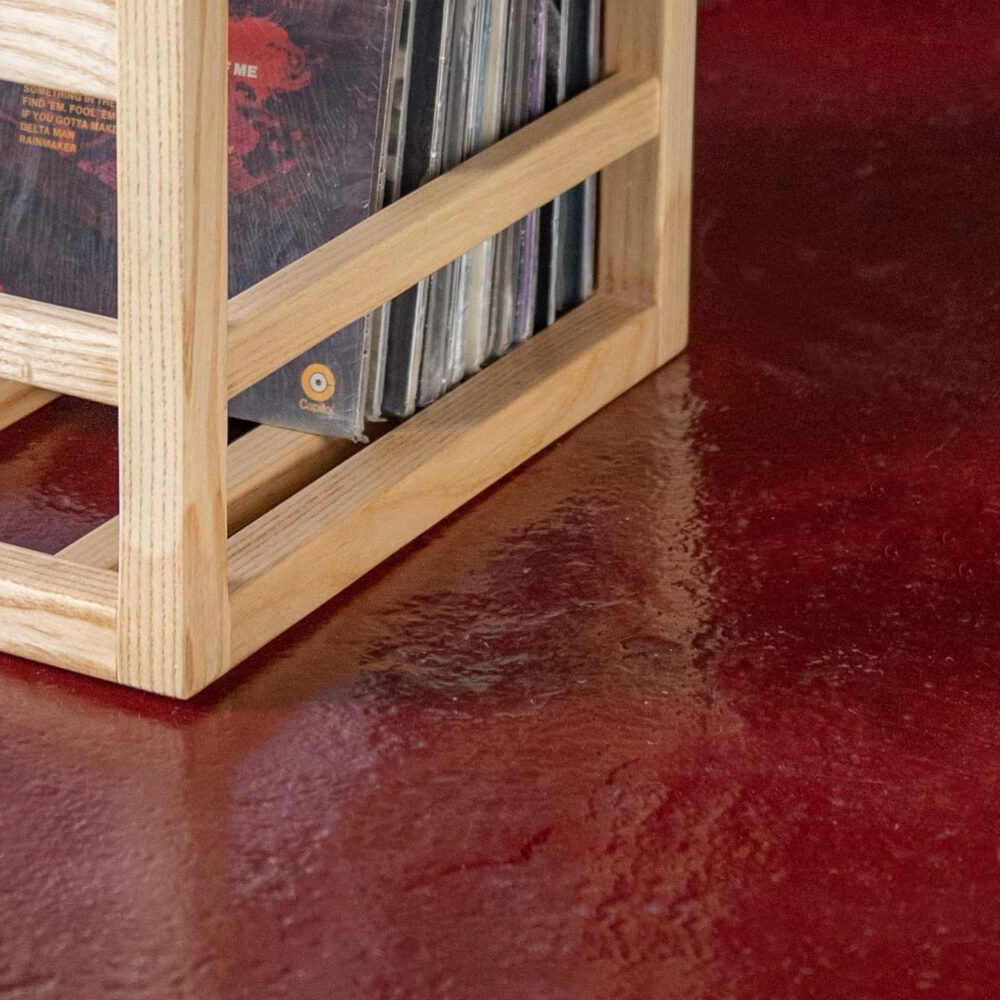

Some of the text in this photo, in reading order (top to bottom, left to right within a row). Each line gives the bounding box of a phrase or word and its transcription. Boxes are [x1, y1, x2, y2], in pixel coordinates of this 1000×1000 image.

[233, 64, 258, 79] ME
[22, 96, 46, 108] FIND
[69, 104, 96, 117] FOOL
[21, 109, 30, 118] IF
[33, 111, 53, 122] YOU
[55, 116, 89, 129] GOTTA
[20, 122, 76, 140] DELTA MAN
[19, 134, 77, 153] RAINMAKER
